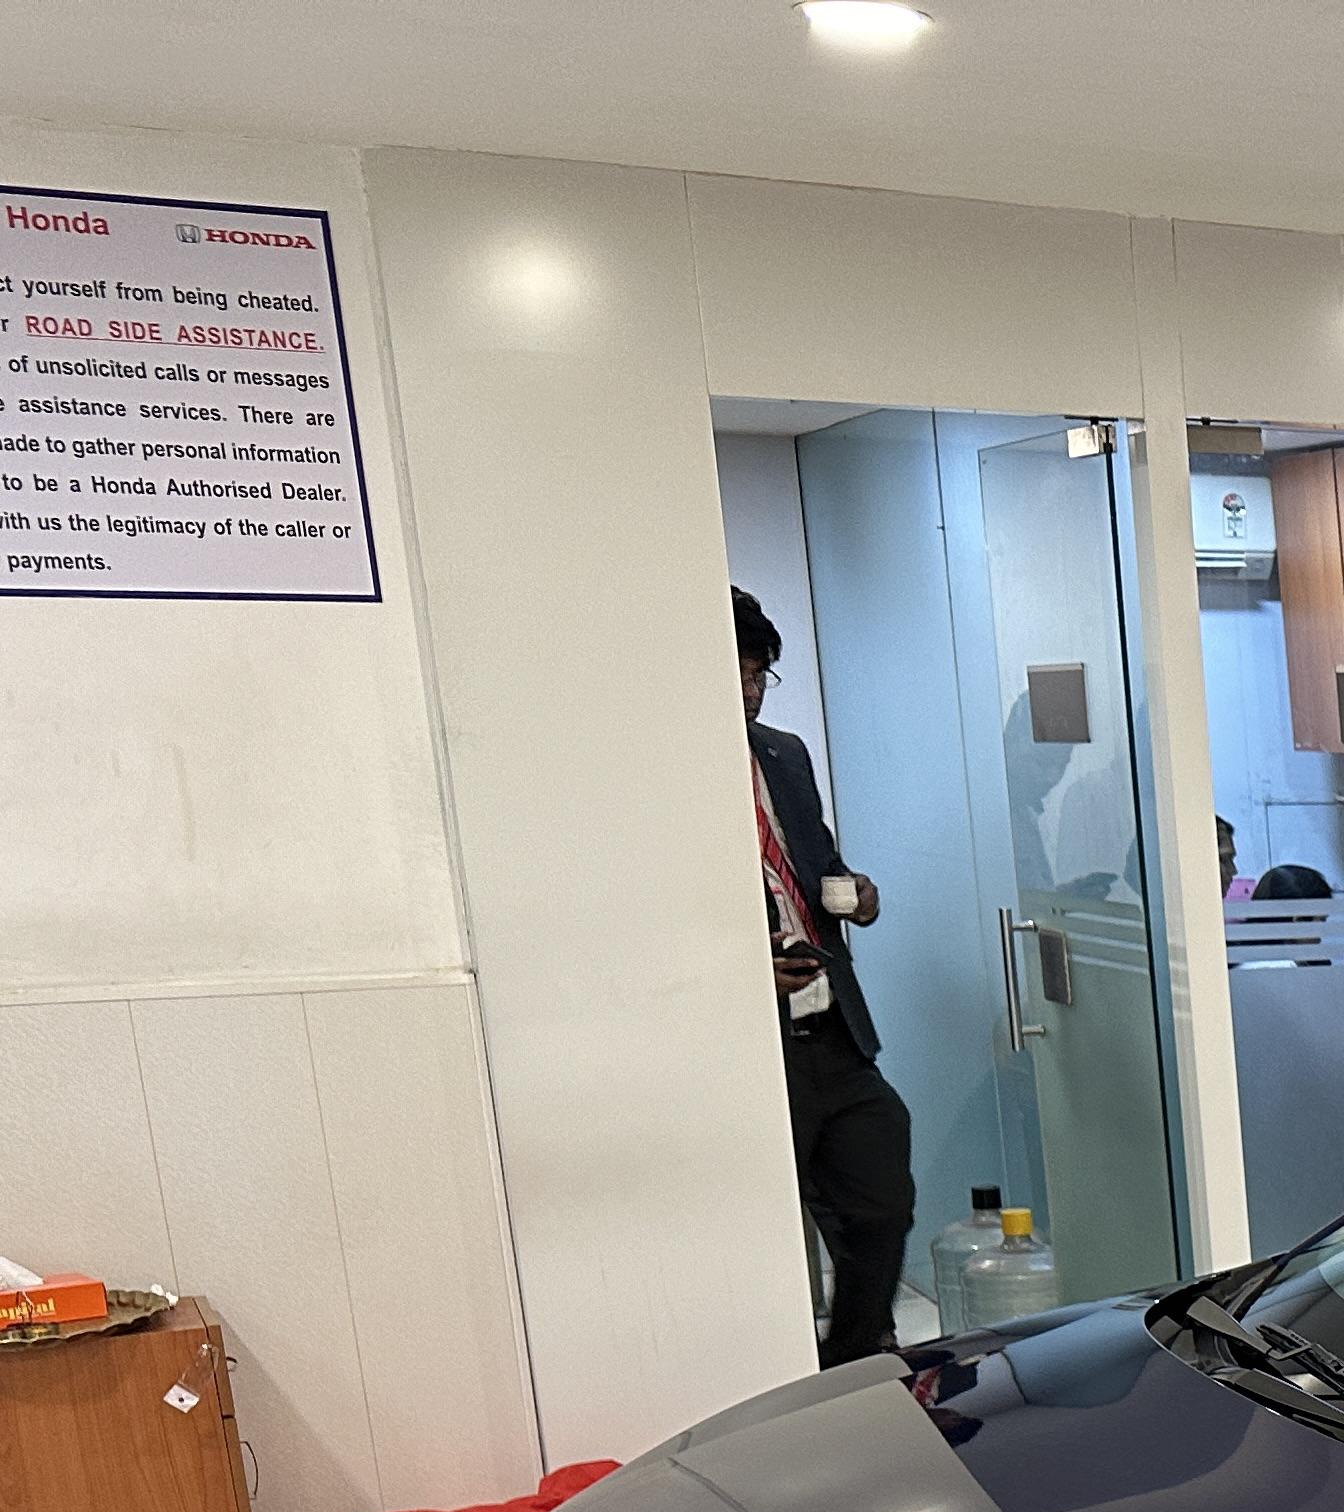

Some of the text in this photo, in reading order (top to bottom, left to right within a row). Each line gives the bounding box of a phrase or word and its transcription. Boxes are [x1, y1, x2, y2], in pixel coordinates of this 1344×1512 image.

[6, 206, 110, 236] Honda
[204, 228, 317, 250] HONDA
[23, 277, 106, 300] yourself
[116, 281, 162, 301] from
[173, 286, 228, 310] being
[238, 291, 319, 313] cheated.
[25, 315, 92, 336] ROAD
[109, 321, 162, 340] SIDE
[178, 326, 325, 351] ASSISTANCE.
[8, 358, 329, 391] of unsolicited calls or messages
[18, 398, 335, 427] assistance services. There are
[46, 438, 65, 453] to
[73, 440, 135, 458] gather
[142, 443, 225, 460] personal
[232, 446, 341, 464] information
[3, 475, 347, 501] to be a Honda Authorised Dealer.
[38, 517, 62, 531] us
[69, 514, 100, 532] the
[107, 515, 206, 537] legitimacy
[214, 519, 233, 536] of
[239, 519, 268, 536] the
[275, 520, 325, 538] caller
[333, 525, 351, 539] or
[7, 552, 111, 573] payments.
